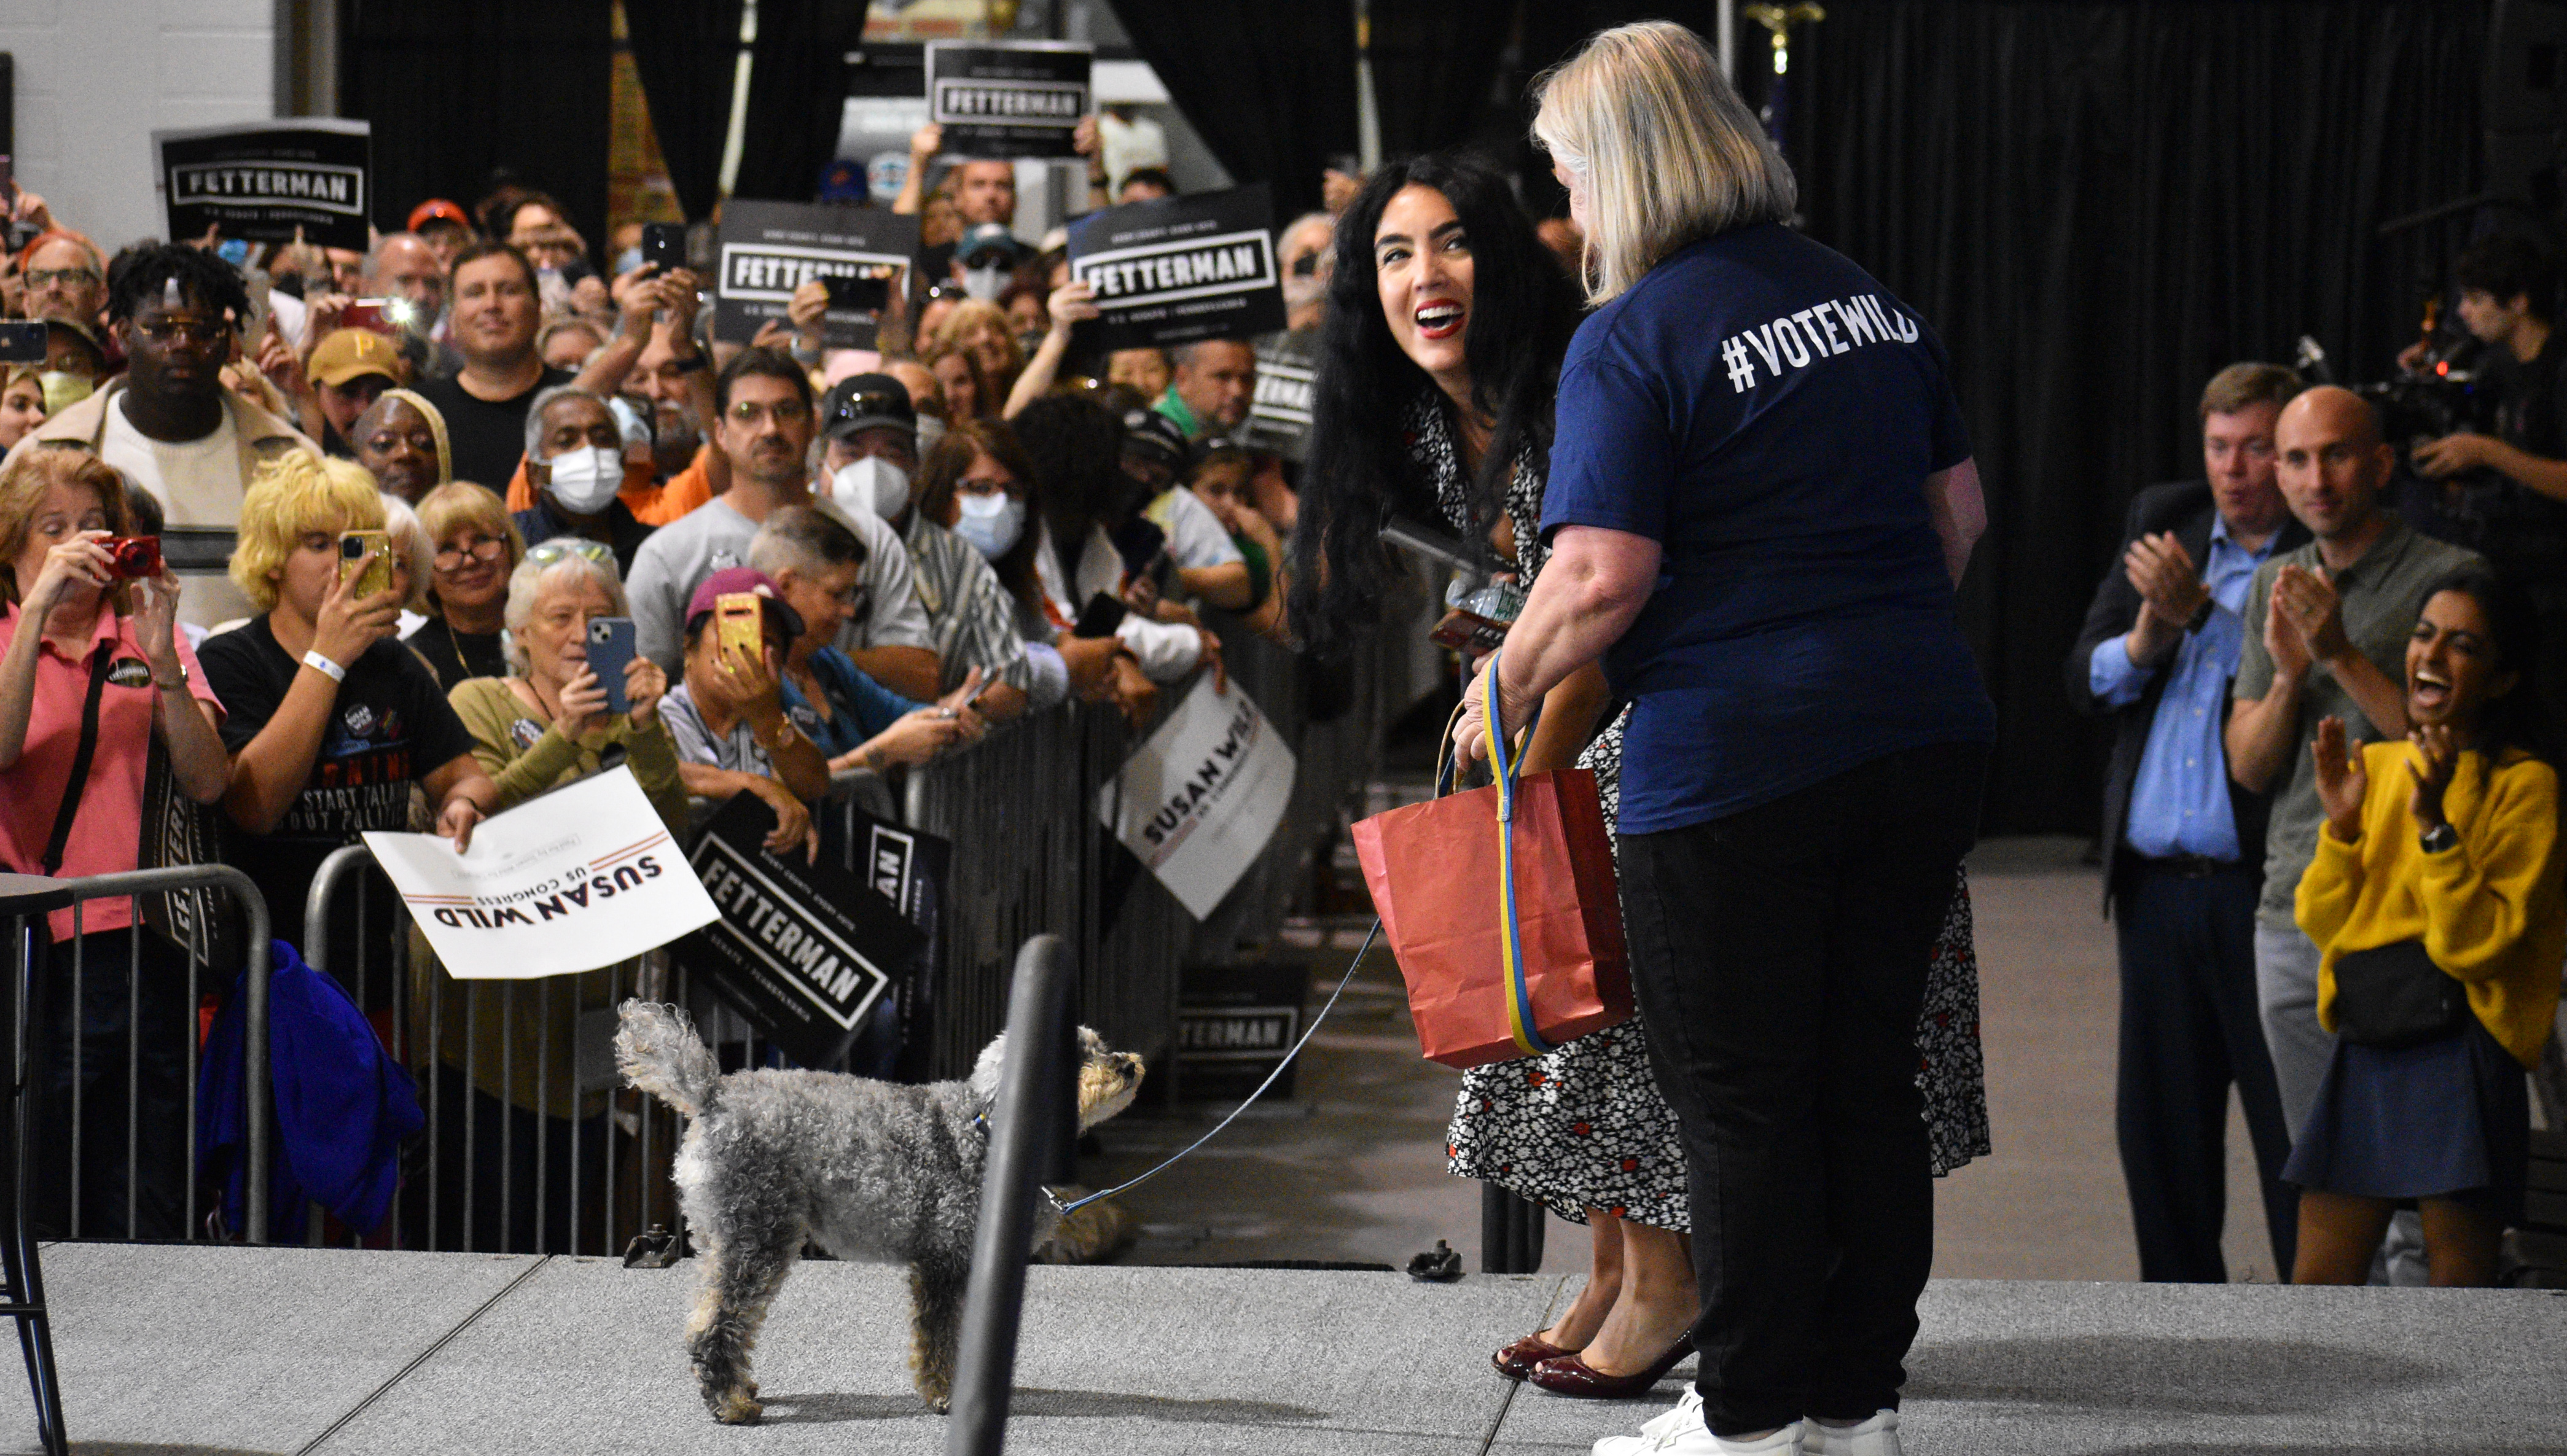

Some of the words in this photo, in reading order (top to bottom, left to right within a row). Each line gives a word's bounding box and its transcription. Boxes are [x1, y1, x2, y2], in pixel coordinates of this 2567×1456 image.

[948, 90, 1077, 115] FETTERMAN
[189, 169, 347, 202] FETTERMAN
[1087, 245, 1257, 297] FETTERMAN
[355, 332, 375, 359] P
[1721, 294, 1919, 394] #VOTEWILD
[303, 786, 357, 811] START
[1143, 758, 1221, 846] SUSAN
[533, 855, 663, 922] SUSAN
[565, 866, 588, 882] US
[476, 878, 561, 906] CONGRESS
[433, 906, 536, 928] WILD
[701, 858, 861, 1004] FETTERMAN
